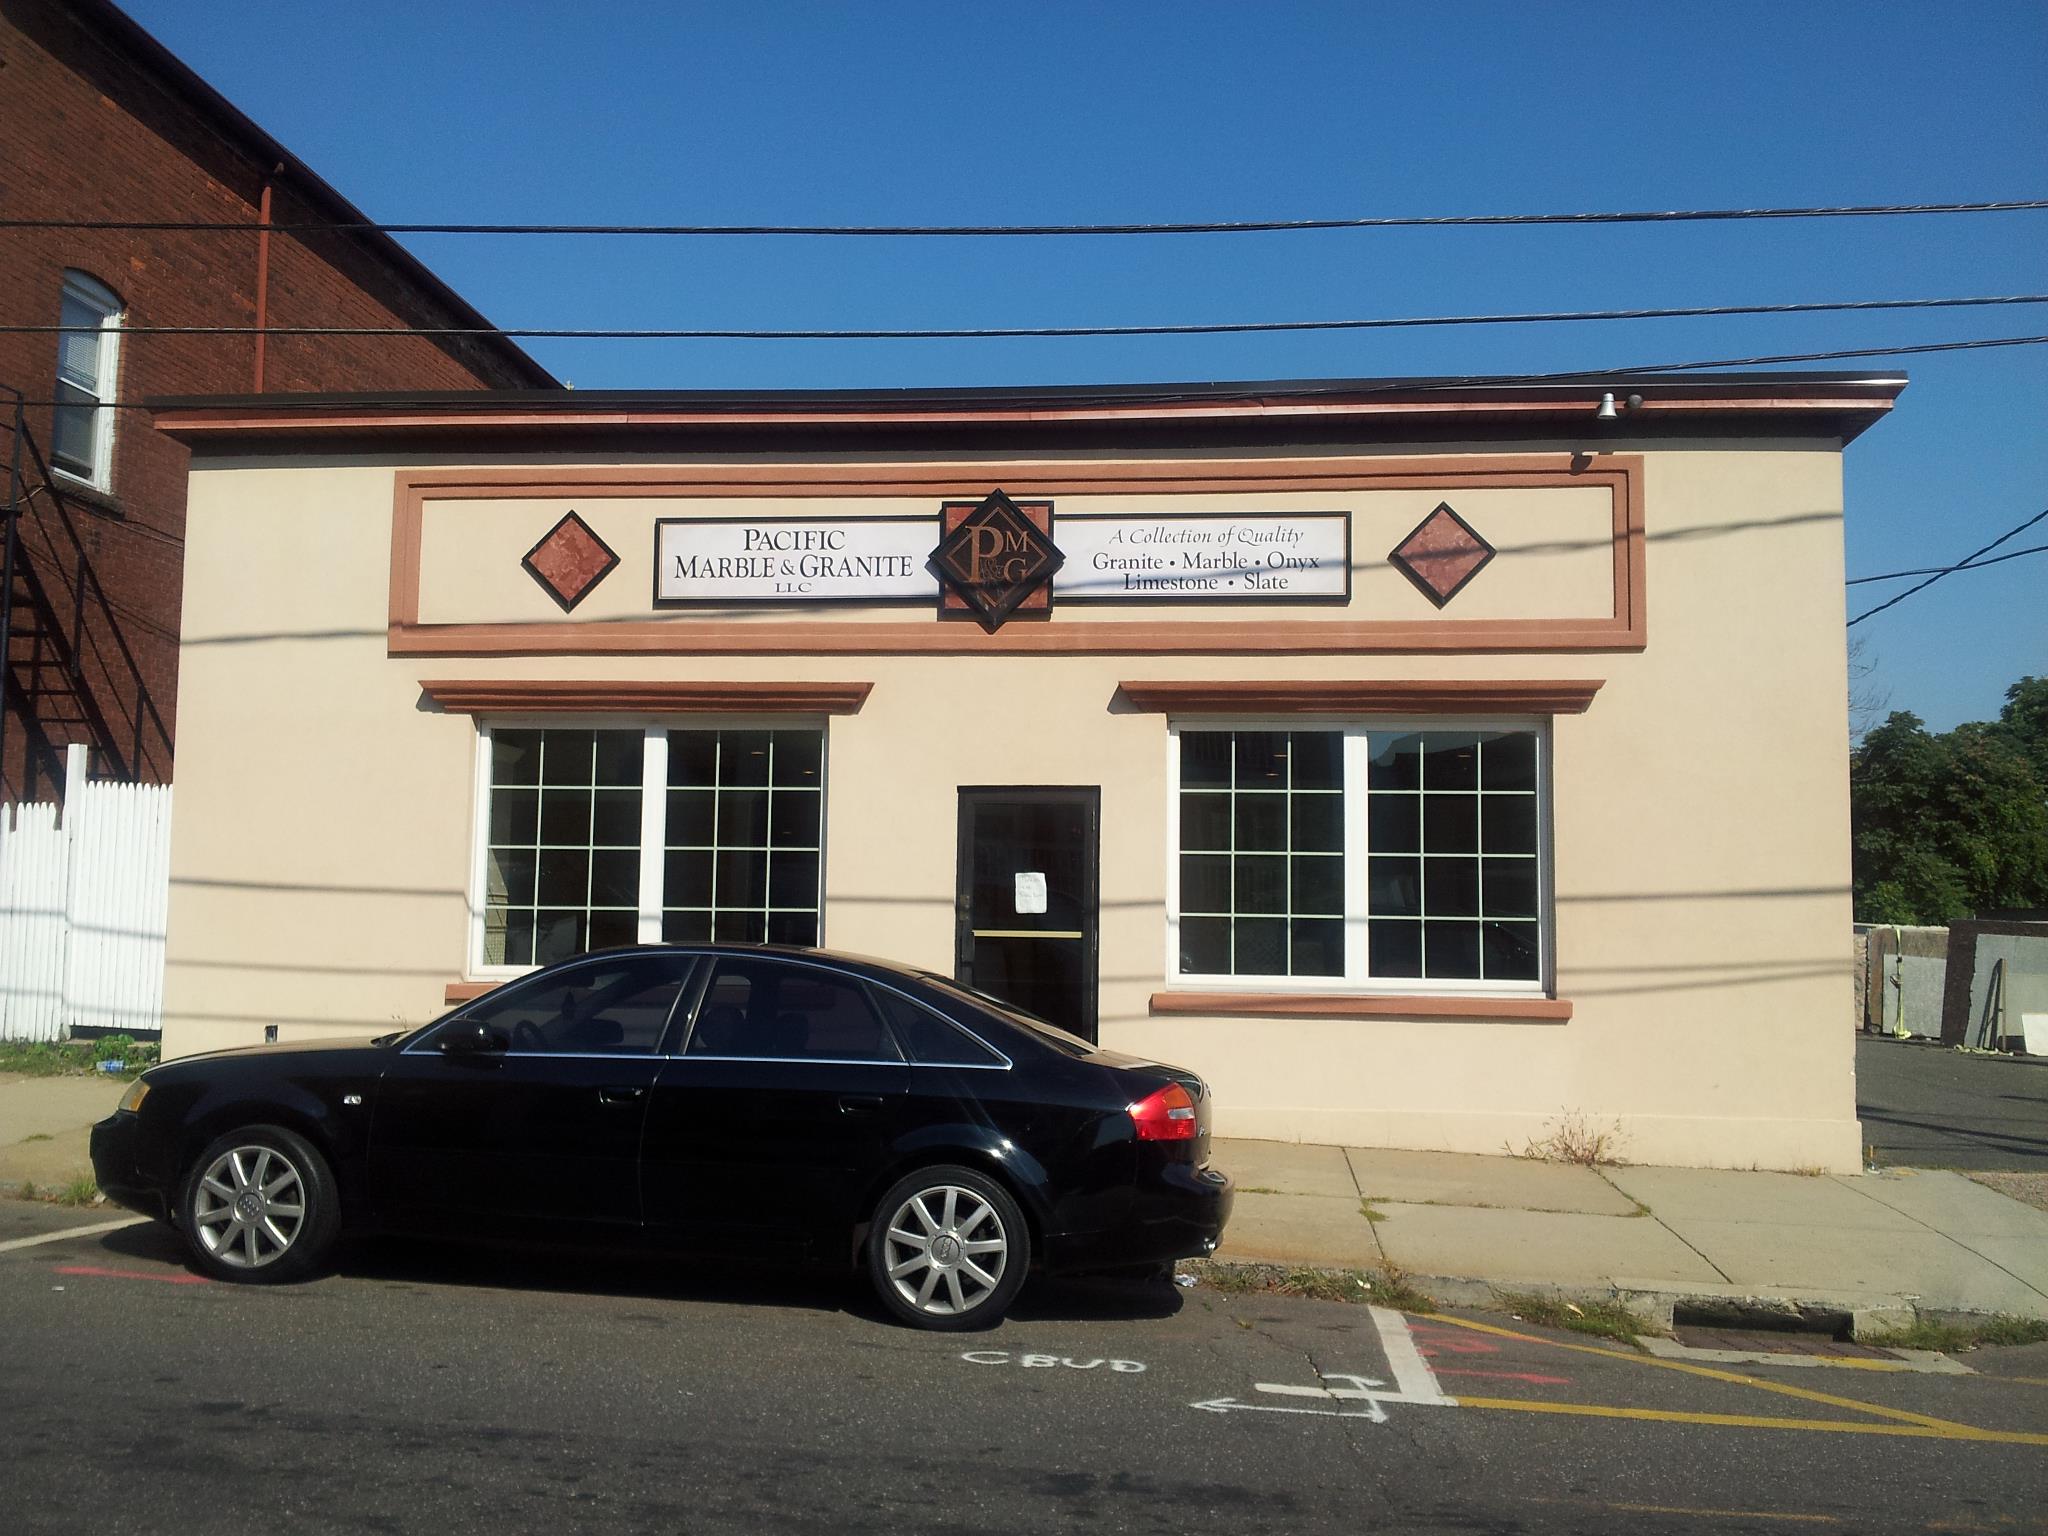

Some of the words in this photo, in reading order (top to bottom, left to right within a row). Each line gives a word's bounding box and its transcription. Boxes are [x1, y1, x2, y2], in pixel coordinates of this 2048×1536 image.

[743, 528, 846, 551] PACIFIC
[1109, 529, 1123, 544] A
[1129, 527, 1211, 545] Collection
[1217, 525, 1235, 548] of
[1237, 525, 1304, 549] Quality
[673, 555, 776, 579] MARBLE
[779, 558, 795, 576] &
[799, 554, 913, 578] GRANITE
[1092, 551, 1164, 571] Granite
[1182, 551, 1248, 570] Marble
[1266, 551, 1320, 573] Onyx
[775, 582, 813, 593] LLC
[1123, 573, 1218, 591] Limestone
[1244, 571, 1289, 590] Slate
